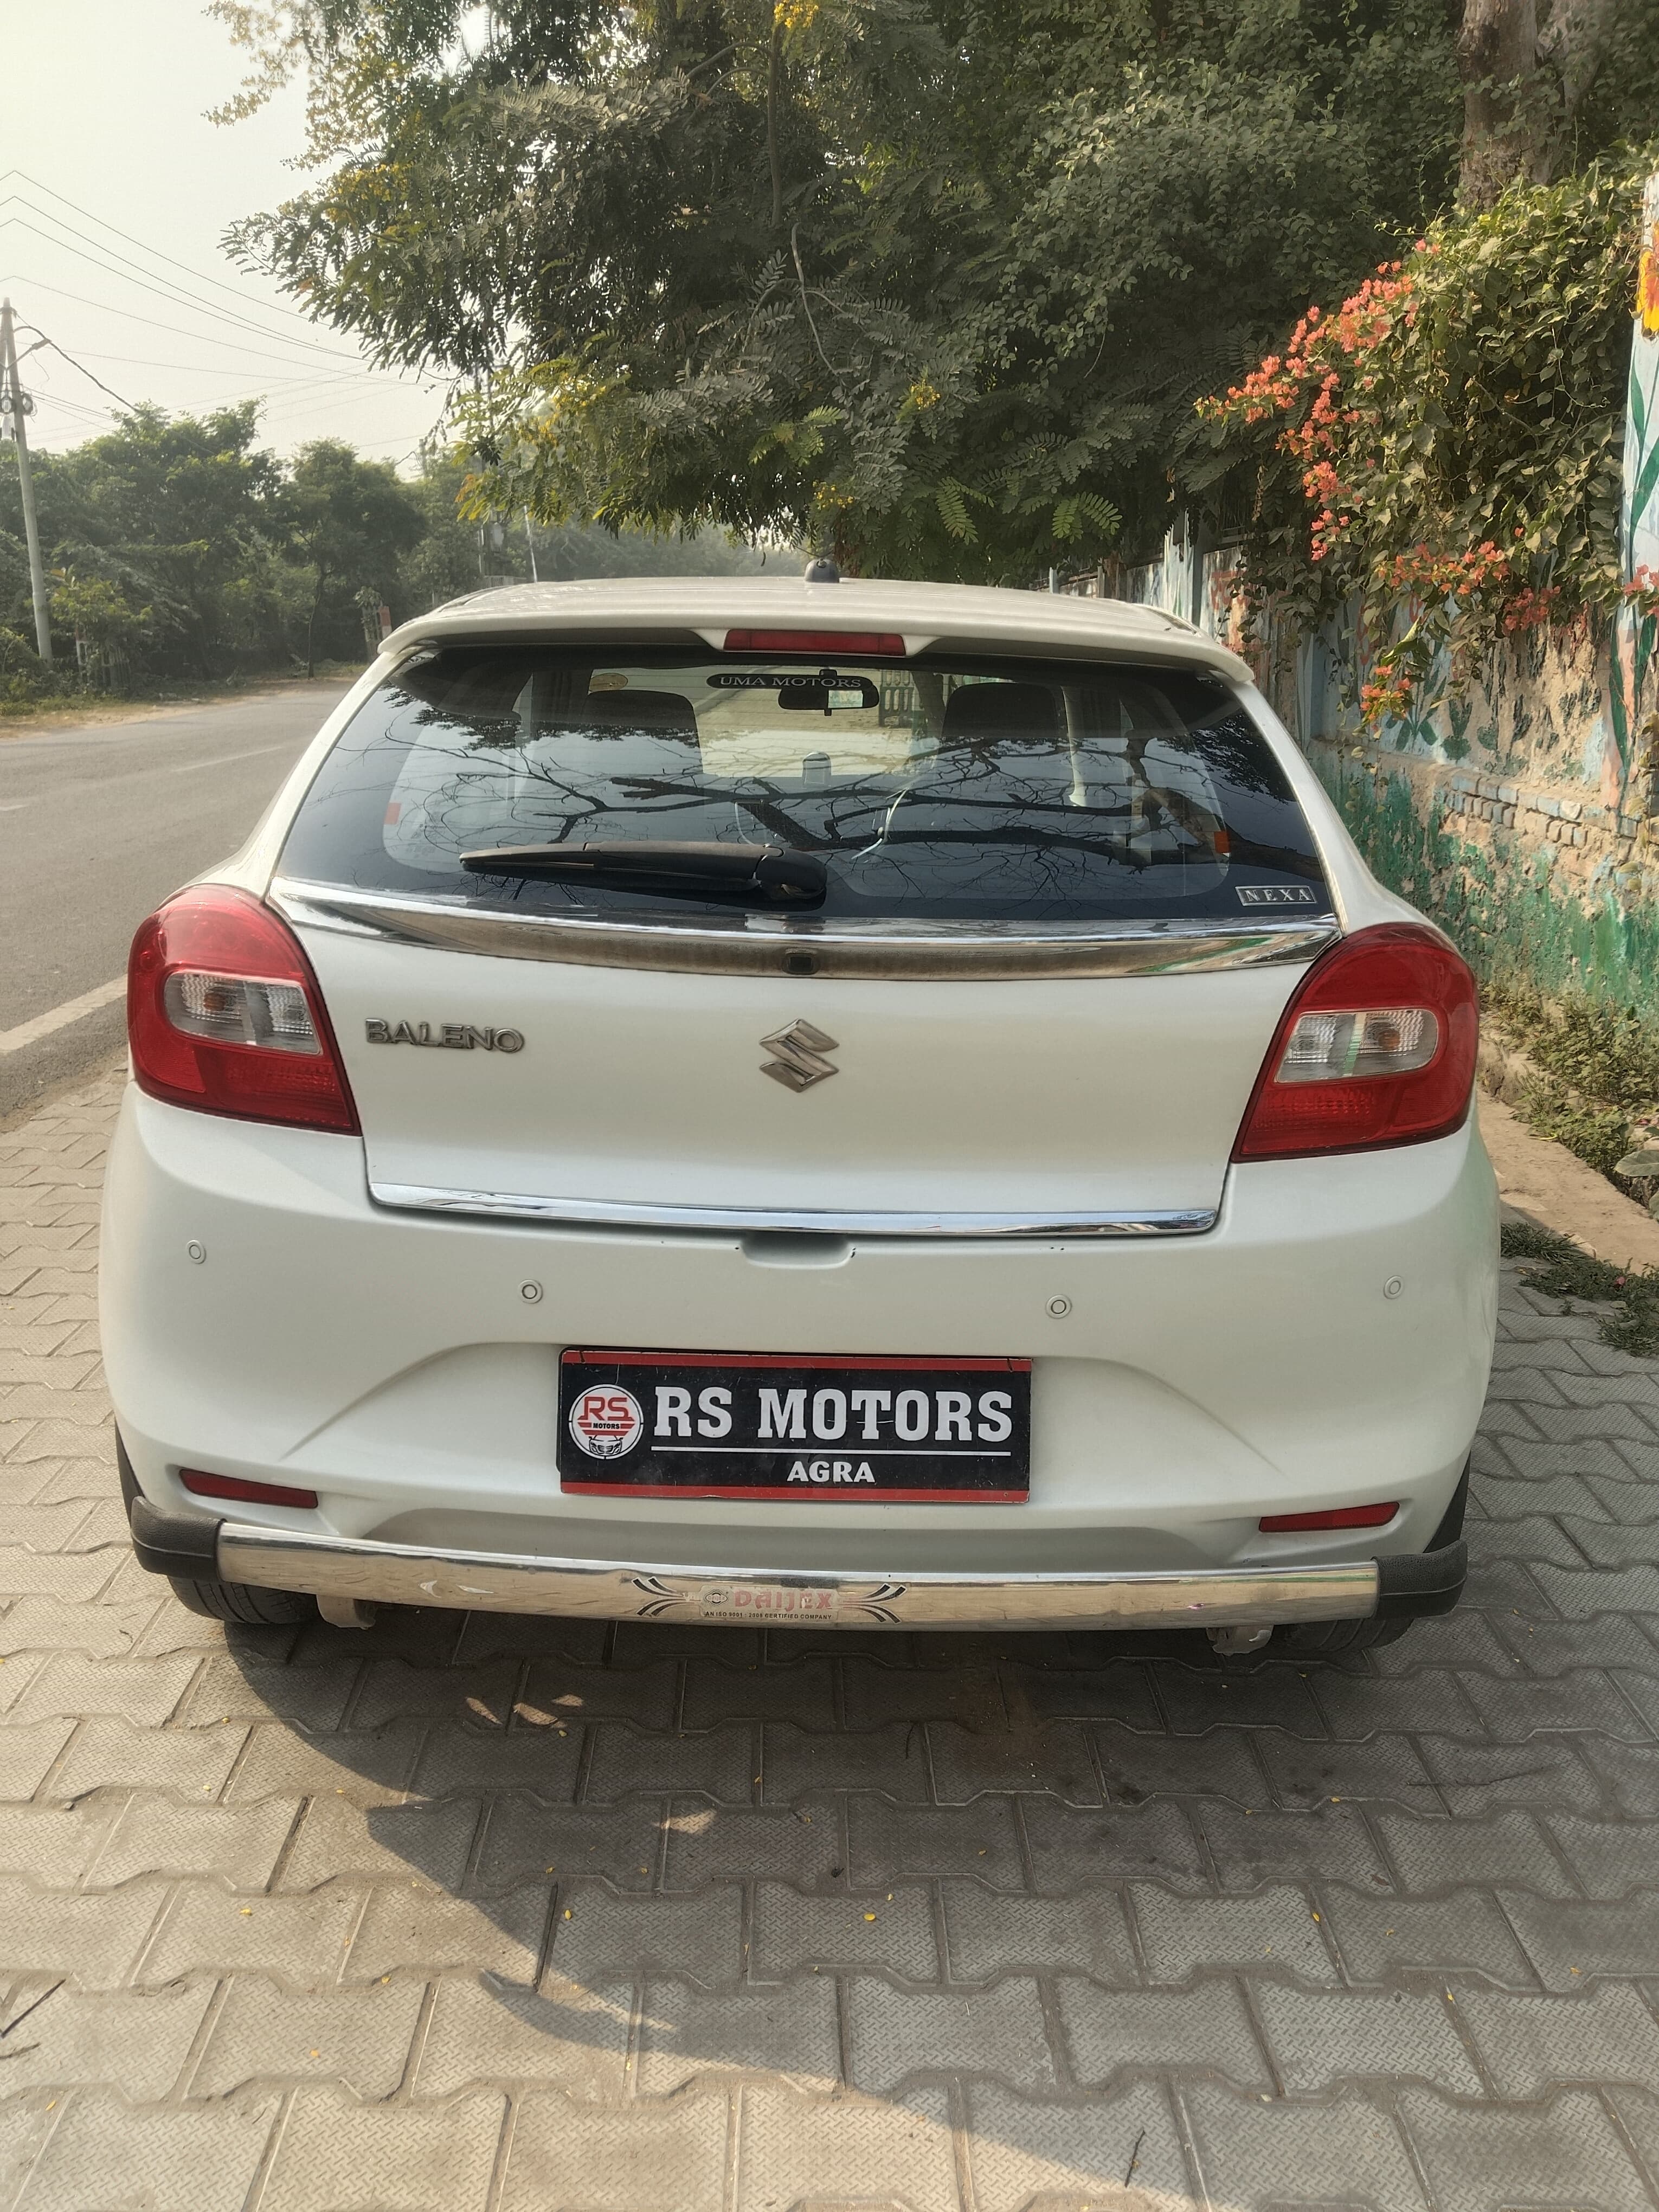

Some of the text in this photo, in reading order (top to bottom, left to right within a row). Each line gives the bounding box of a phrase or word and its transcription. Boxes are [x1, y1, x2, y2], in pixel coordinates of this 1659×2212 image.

[719, 677, 861, 687] UMA MOTORS
[1245, 889, 1311, 902] NEXA
[365, 1018, 524, 1053] BALENO
[577, 1396, 635, 1422] RS
[654, 1386, 1012, 1442] RS MOTORS
[787, 1461, 875, 1482] AGRA
[734, 1590, 833, 1612] DAIJEX
